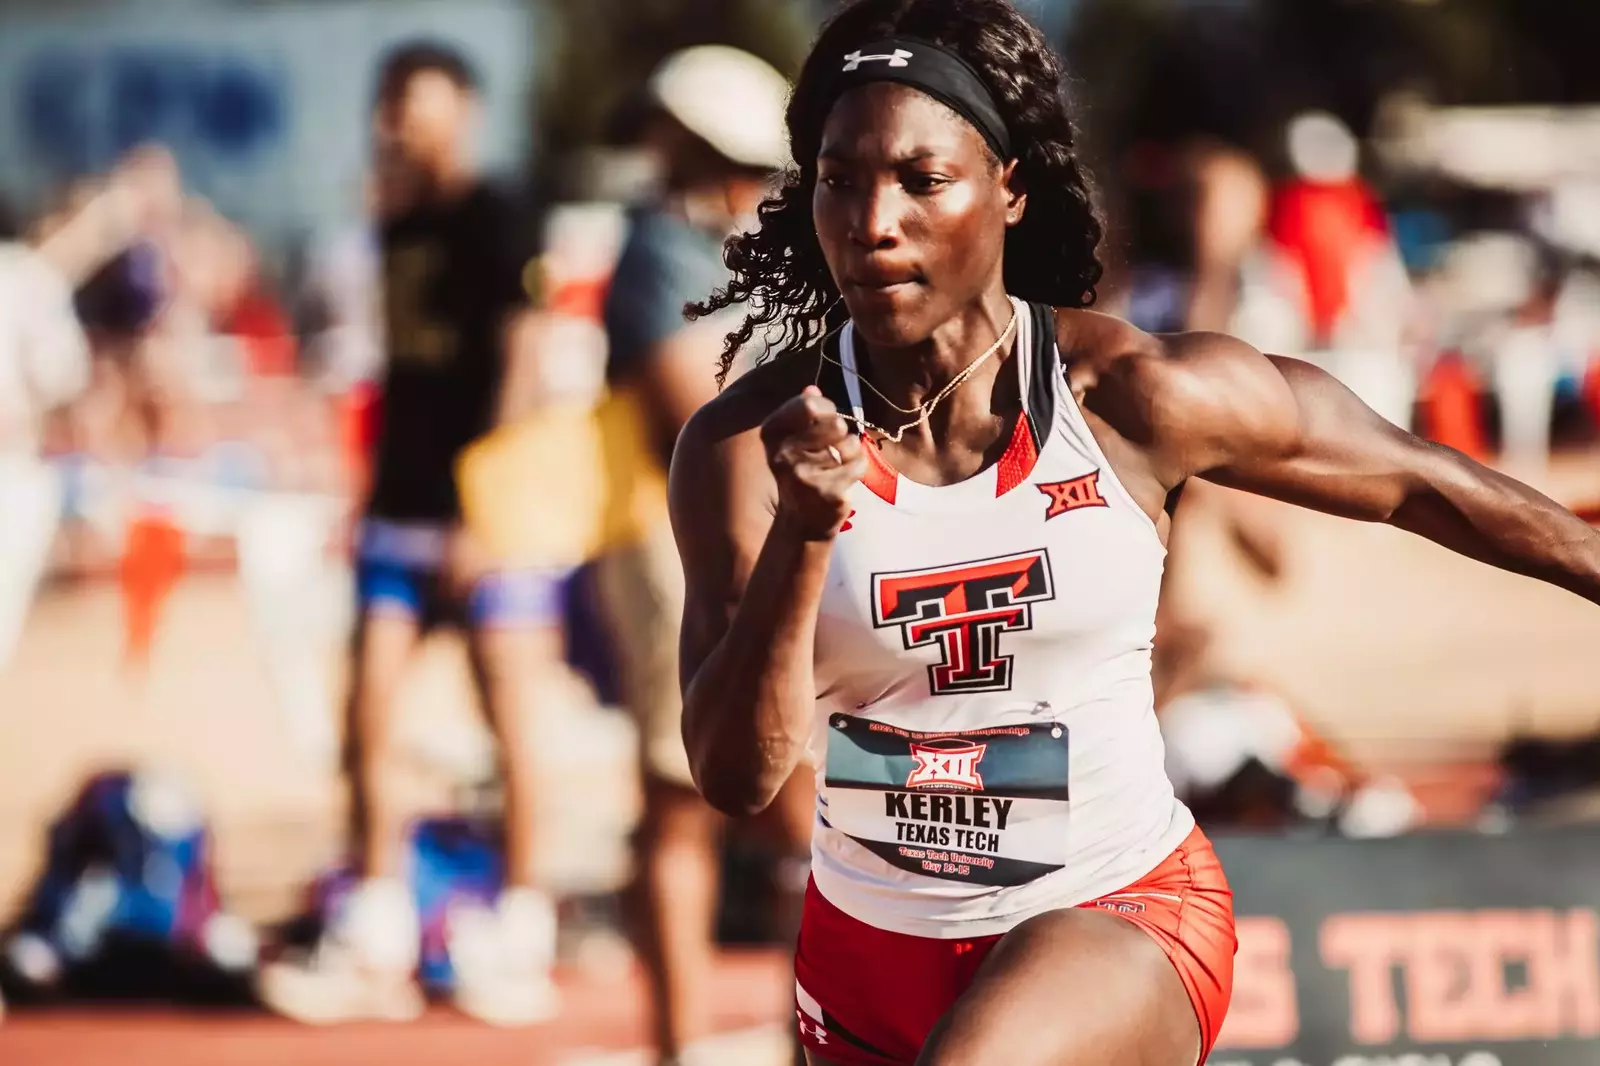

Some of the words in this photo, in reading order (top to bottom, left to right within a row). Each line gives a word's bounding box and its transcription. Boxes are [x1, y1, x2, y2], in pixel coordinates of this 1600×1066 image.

[1037, 469, 1110, 521] XII
[911, 748, 981, 786] XII
[885, 792, 1013, 830] KERLEY
[895, 821, 950, 846] TEXAS
[955, 829, 999, 852] TECH
[899, 846, 925, 858] Texas
[926, 849, 949, 861] Tech
[950, 852, 995, 869] University
[922, 860, 941, 873] May
[943, 863, 970, 875] 13-15
